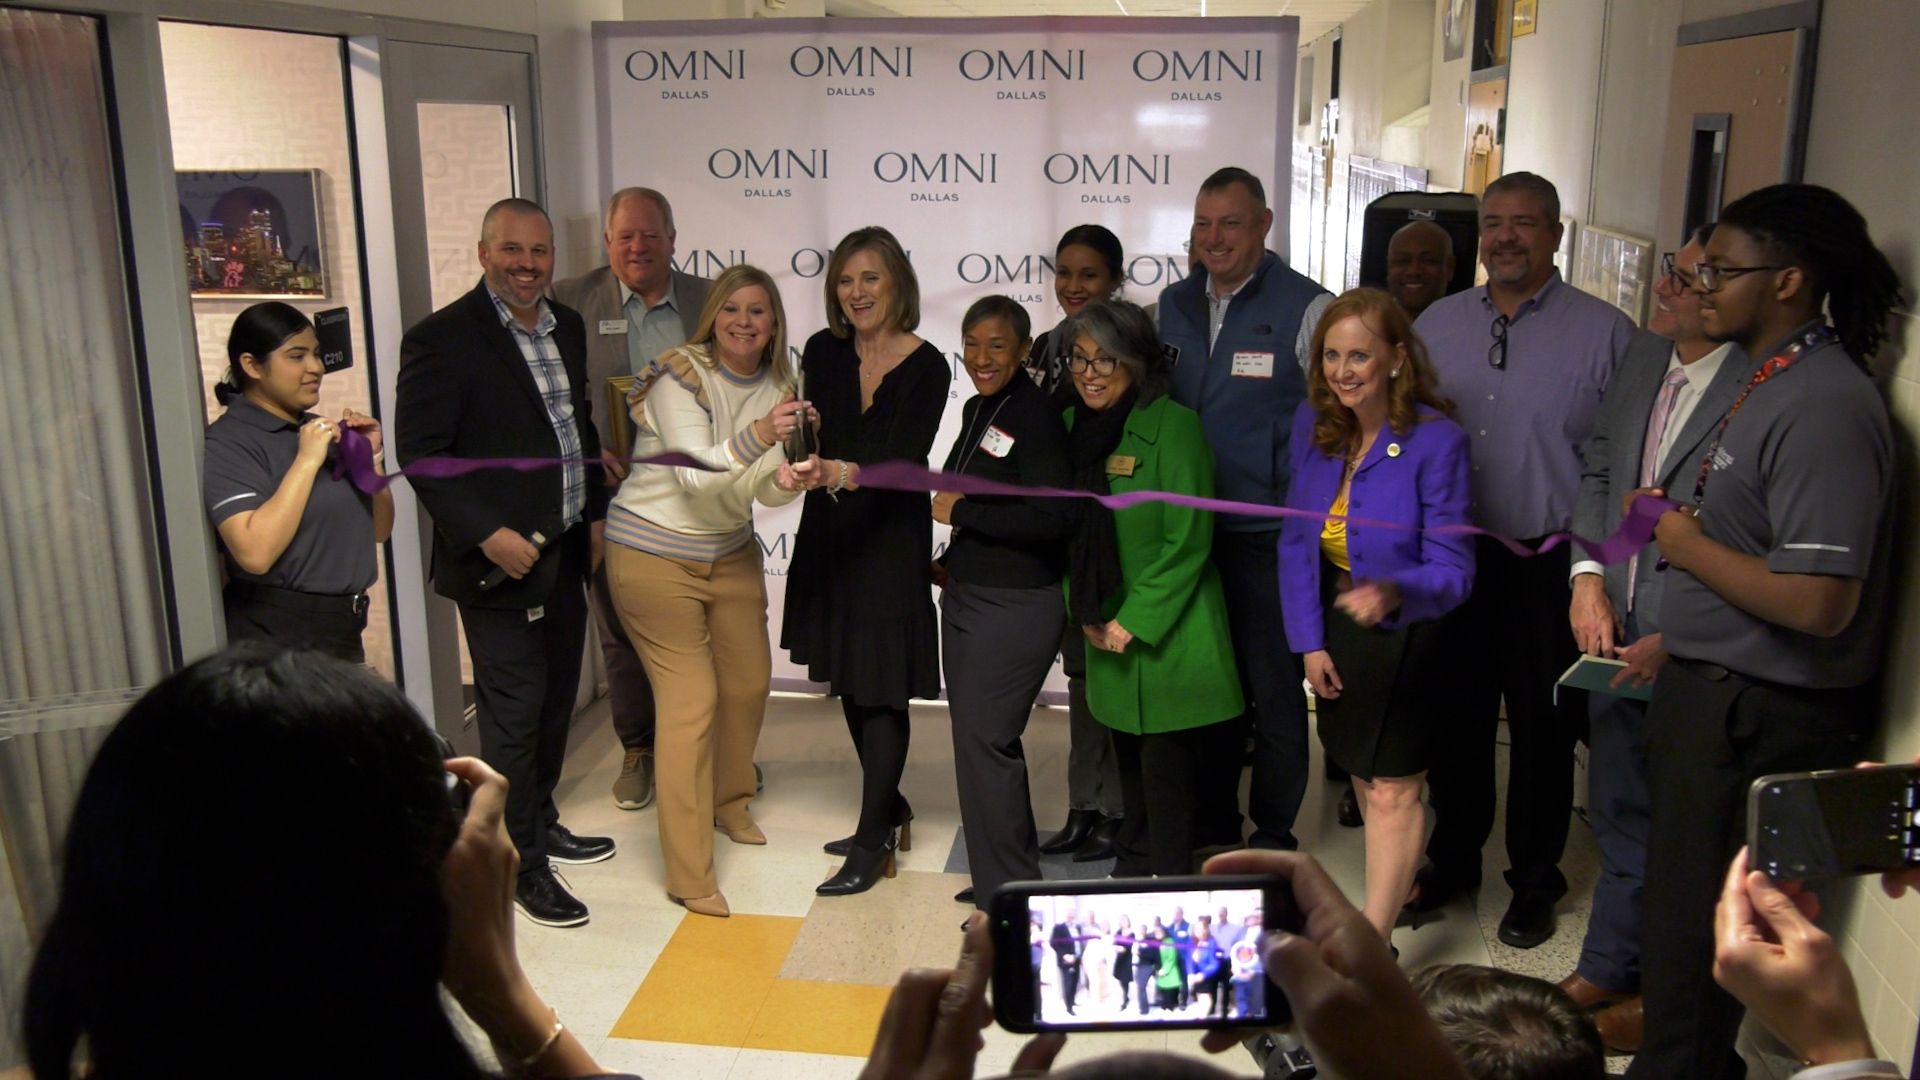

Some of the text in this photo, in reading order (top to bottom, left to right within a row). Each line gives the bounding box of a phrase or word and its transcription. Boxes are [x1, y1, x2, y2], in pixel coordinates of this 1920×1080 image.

[625, 50, 745, 81] OMNI
[790, 46, 913, 78] OMNI
[958, 49, 1085, 82] OMNI
[1132, 50, 1262, 82] OMNI
[661, 90, 709, 100] DALLAS
[826, 87, 875, 97] DALLAS
[996, 90, 1047, 100] DALLAS
[1170, 91, 1222, 102] DALLAS
[708, 148, 828, 180] OMNI
[873, 151, 997, 184] OMNI
[1043, 152, 1171, 185] OMNI
[744, 188, 792, 198] DALLAS
[910, 193, 959, 202] DALLAS
[1081, 194, 1131, 204] DALLAS
[671, 250, 746, 278] MNI
[957, 253, 1057, 285] OMN
[324, 351, 343, 365] C210
